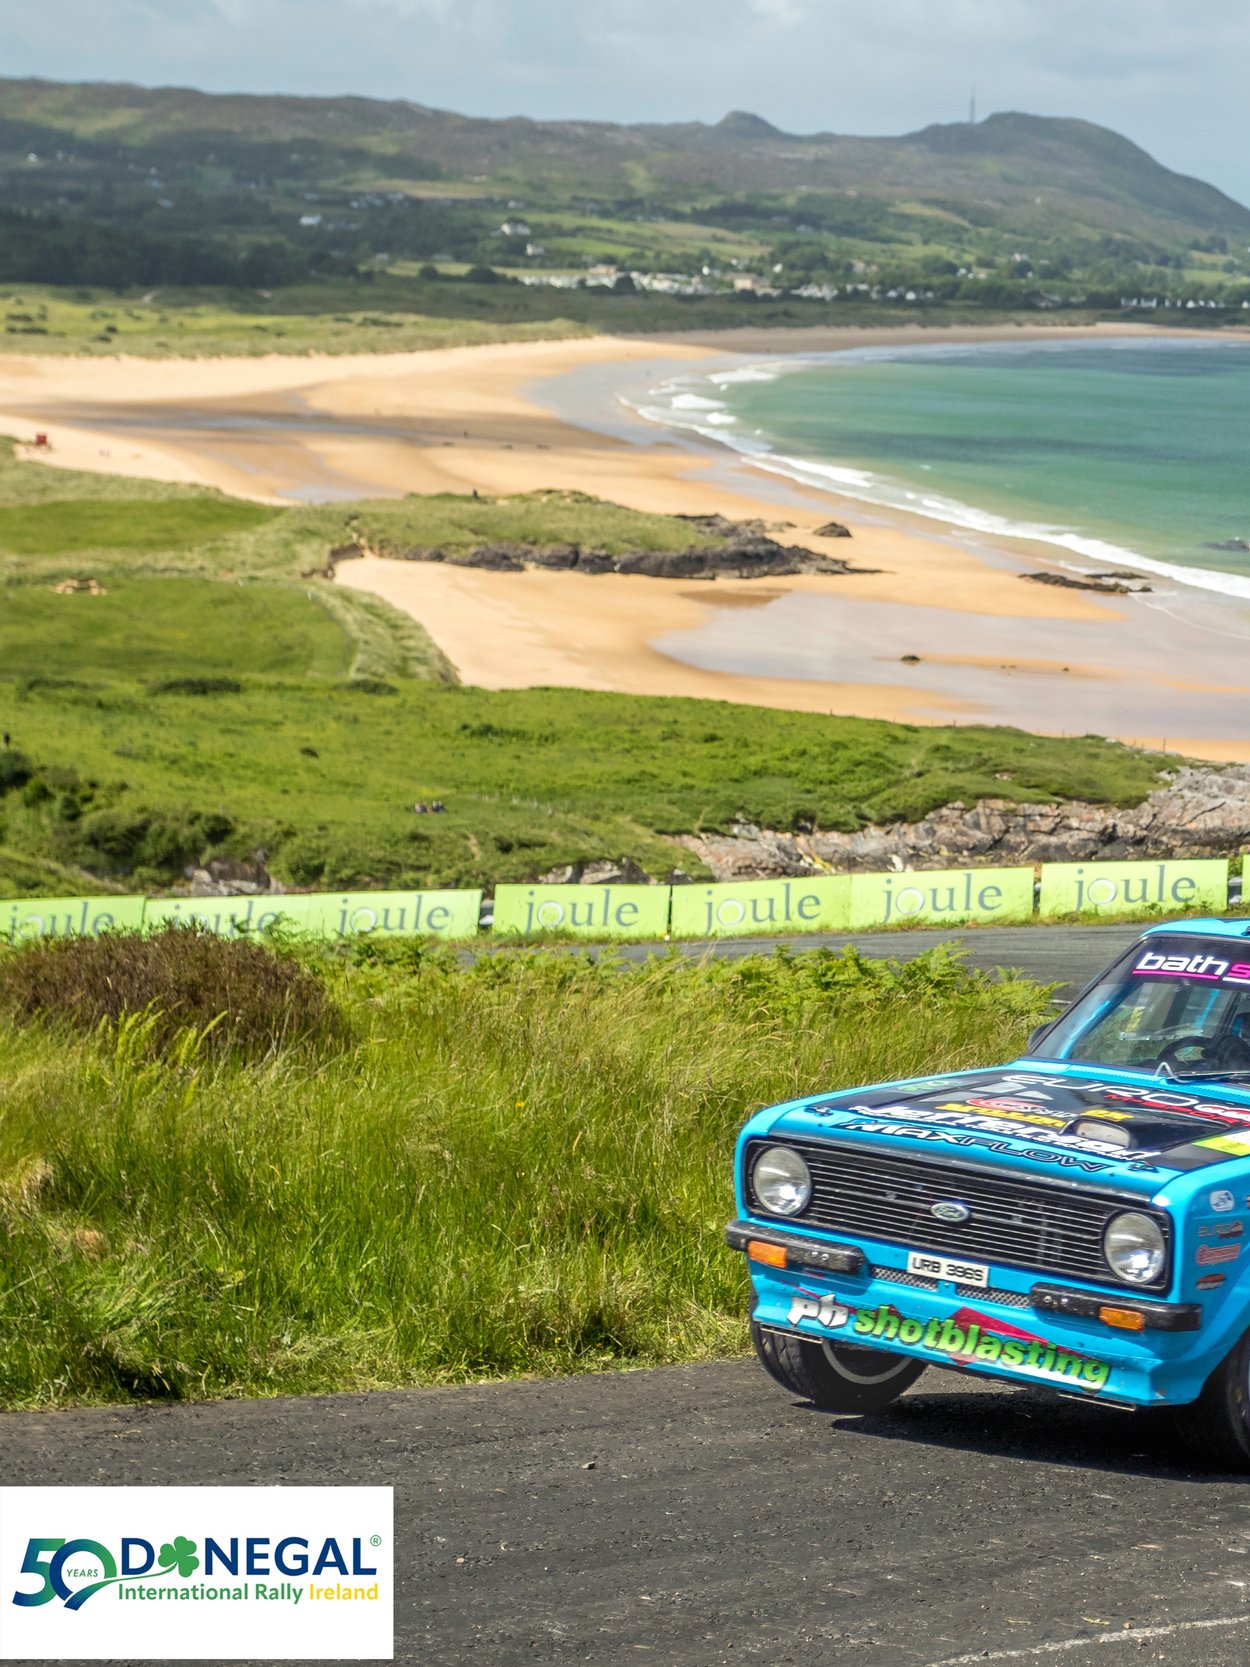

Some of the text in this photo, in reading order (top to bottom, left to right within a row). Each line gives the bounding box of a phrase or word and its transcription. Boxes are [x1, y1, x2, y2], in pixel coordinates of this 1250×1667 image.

[705, 882, 822, 935] joule
[882, 873, 1003, 924] joule
[1075, 864, 1197, 911] joule
[10, 902, 115, 945] joule
[339, 894, 450, 936] joule
[525, 888, 640, 934] joule
[912, 1257, 942, 1275] URB
[854, 1305, 1111, 1389] shotblasting
